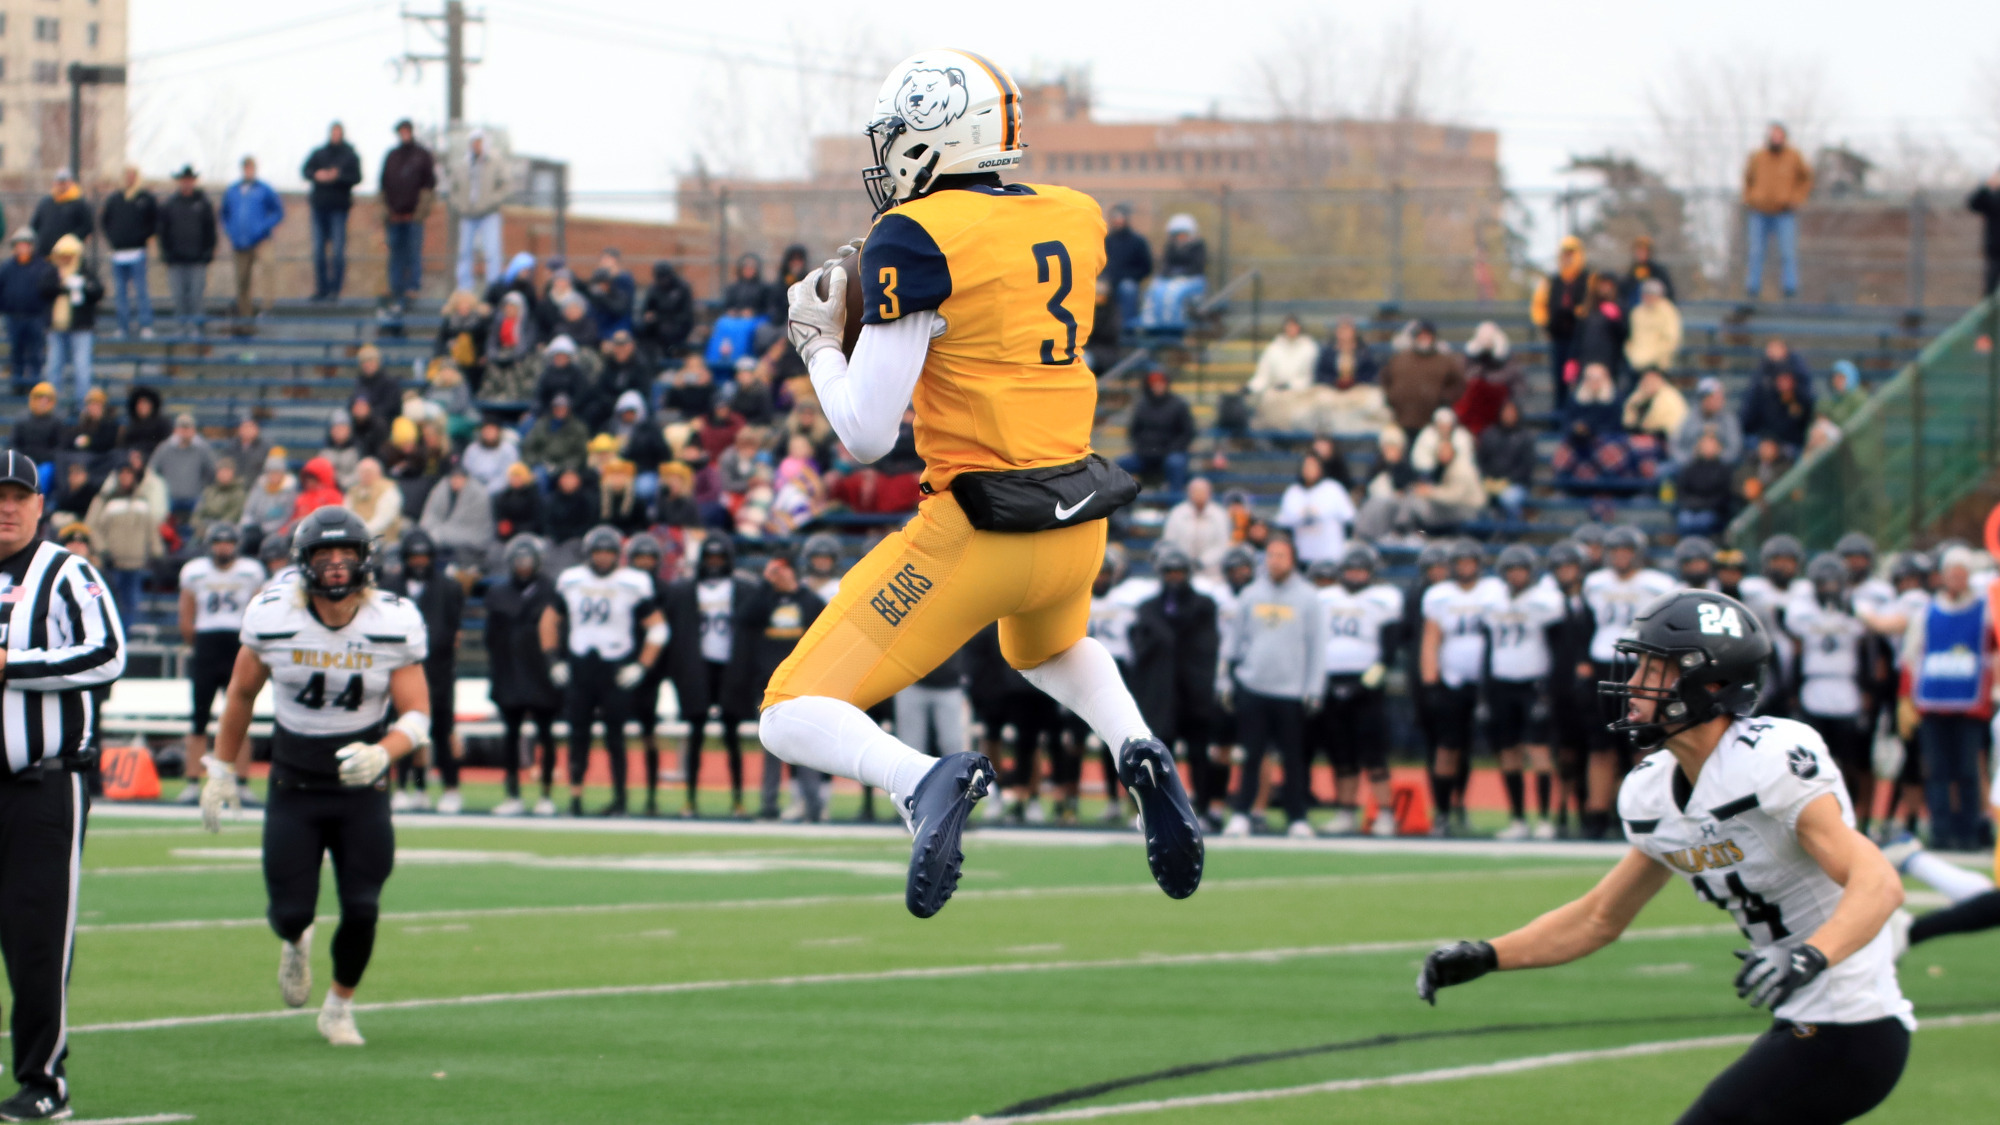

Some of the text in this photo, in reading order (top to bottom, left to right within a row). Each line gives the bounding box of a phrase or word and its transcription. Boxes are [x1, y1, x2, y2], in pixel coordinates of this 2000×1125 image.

[978, 158, 1011, 169] GOLDEN
[878, 266, 901, 320] 3
[1031, 240, 1078, 365] 3
[869, 563, 933, 627] BEARS
[1697, 603, 1744, 639] 24
[291, 650, 373, 669] WILDCATS
[294, 672, 364, 711] 44
[102, 752, 139, 788] 40
